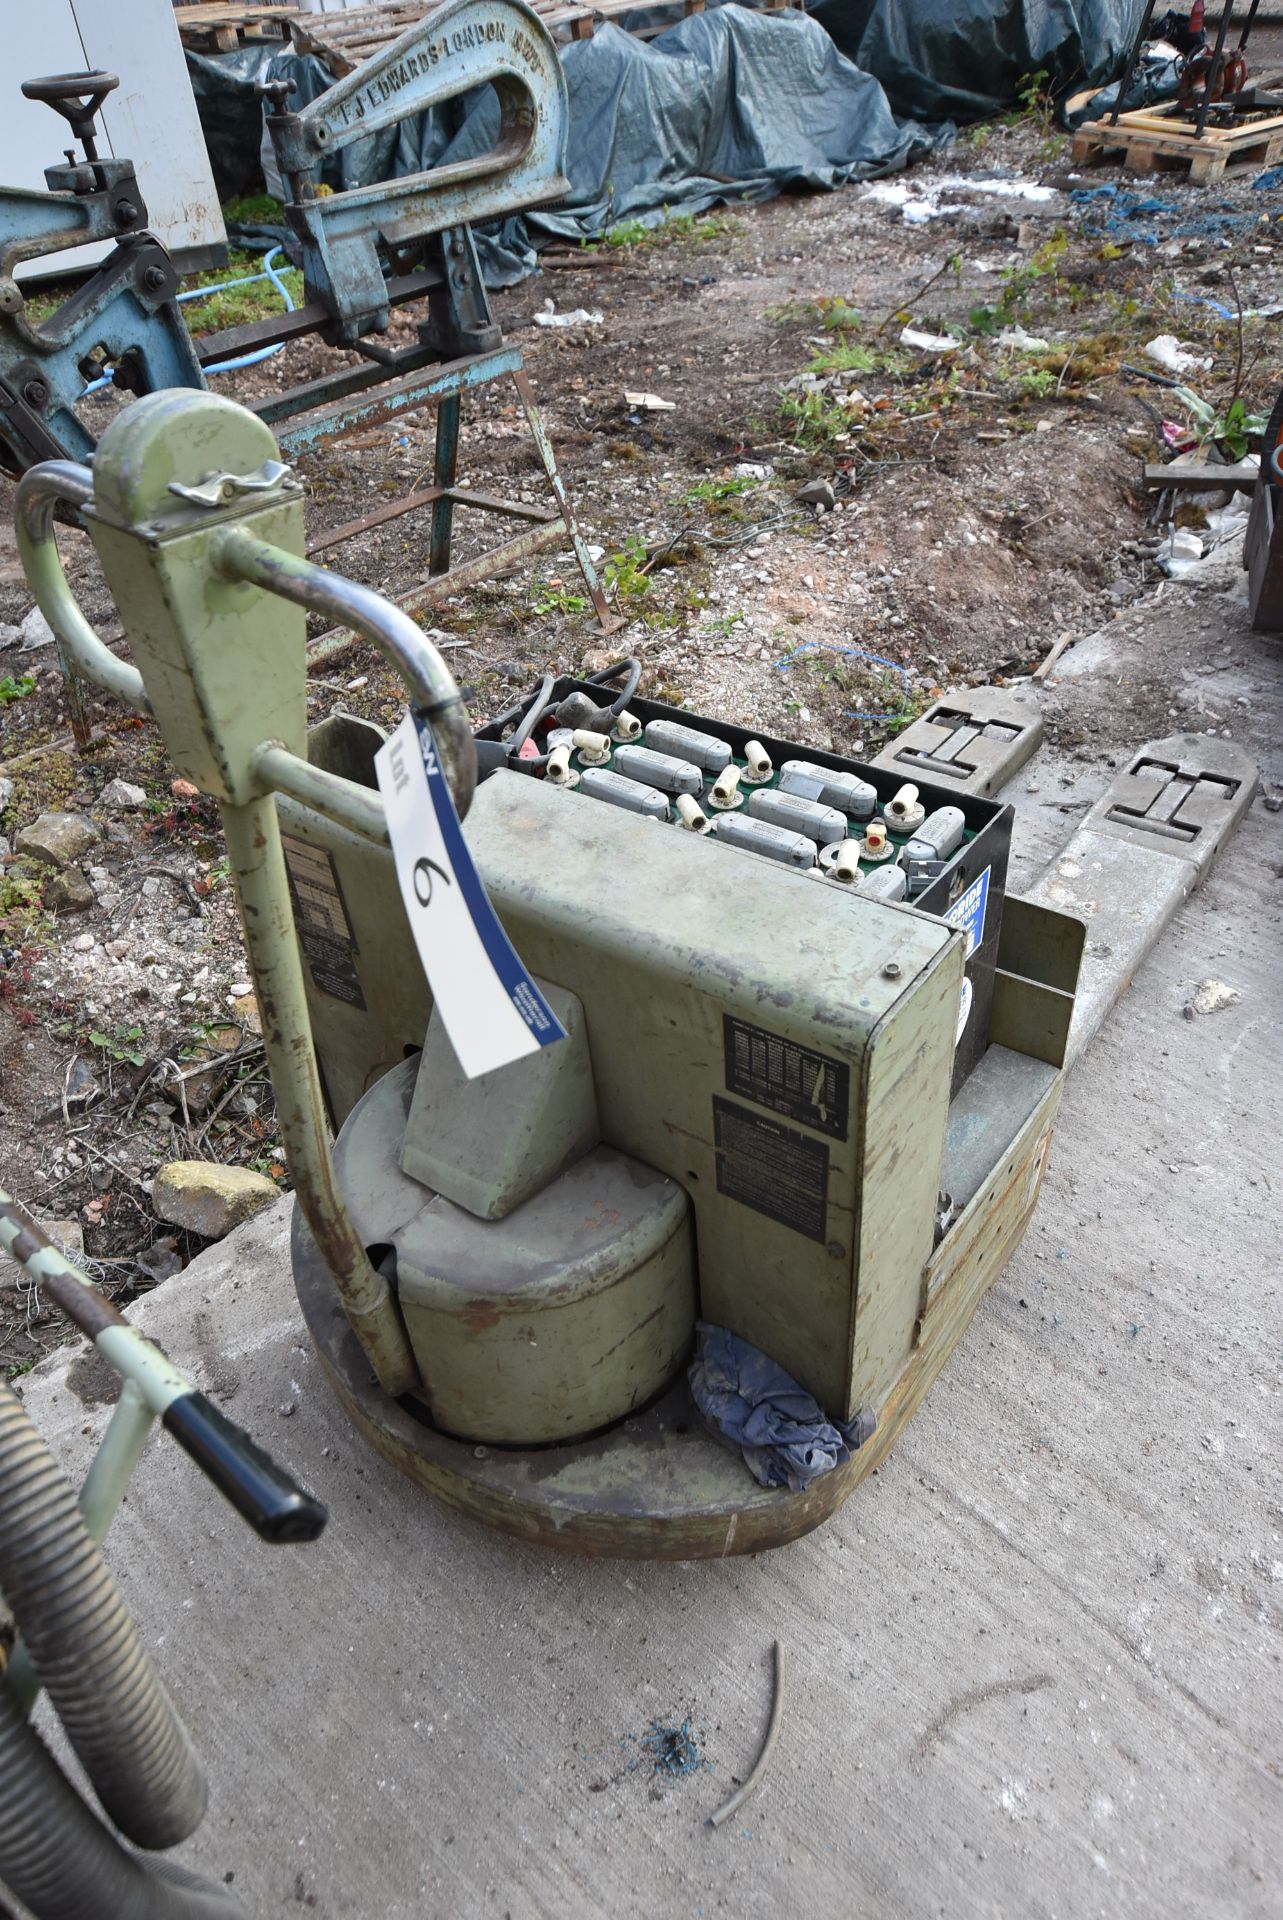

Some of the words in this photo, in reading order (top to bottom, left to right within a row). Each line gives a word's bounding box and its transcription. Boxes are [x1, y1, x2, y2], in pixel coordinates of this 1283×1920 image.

[366, 41, 439, 108] EDWARDS
[442, 21, 505, 57] LONDON
[389, 738, 411, 796] Lot
[413, 856, 451, 908] 6
